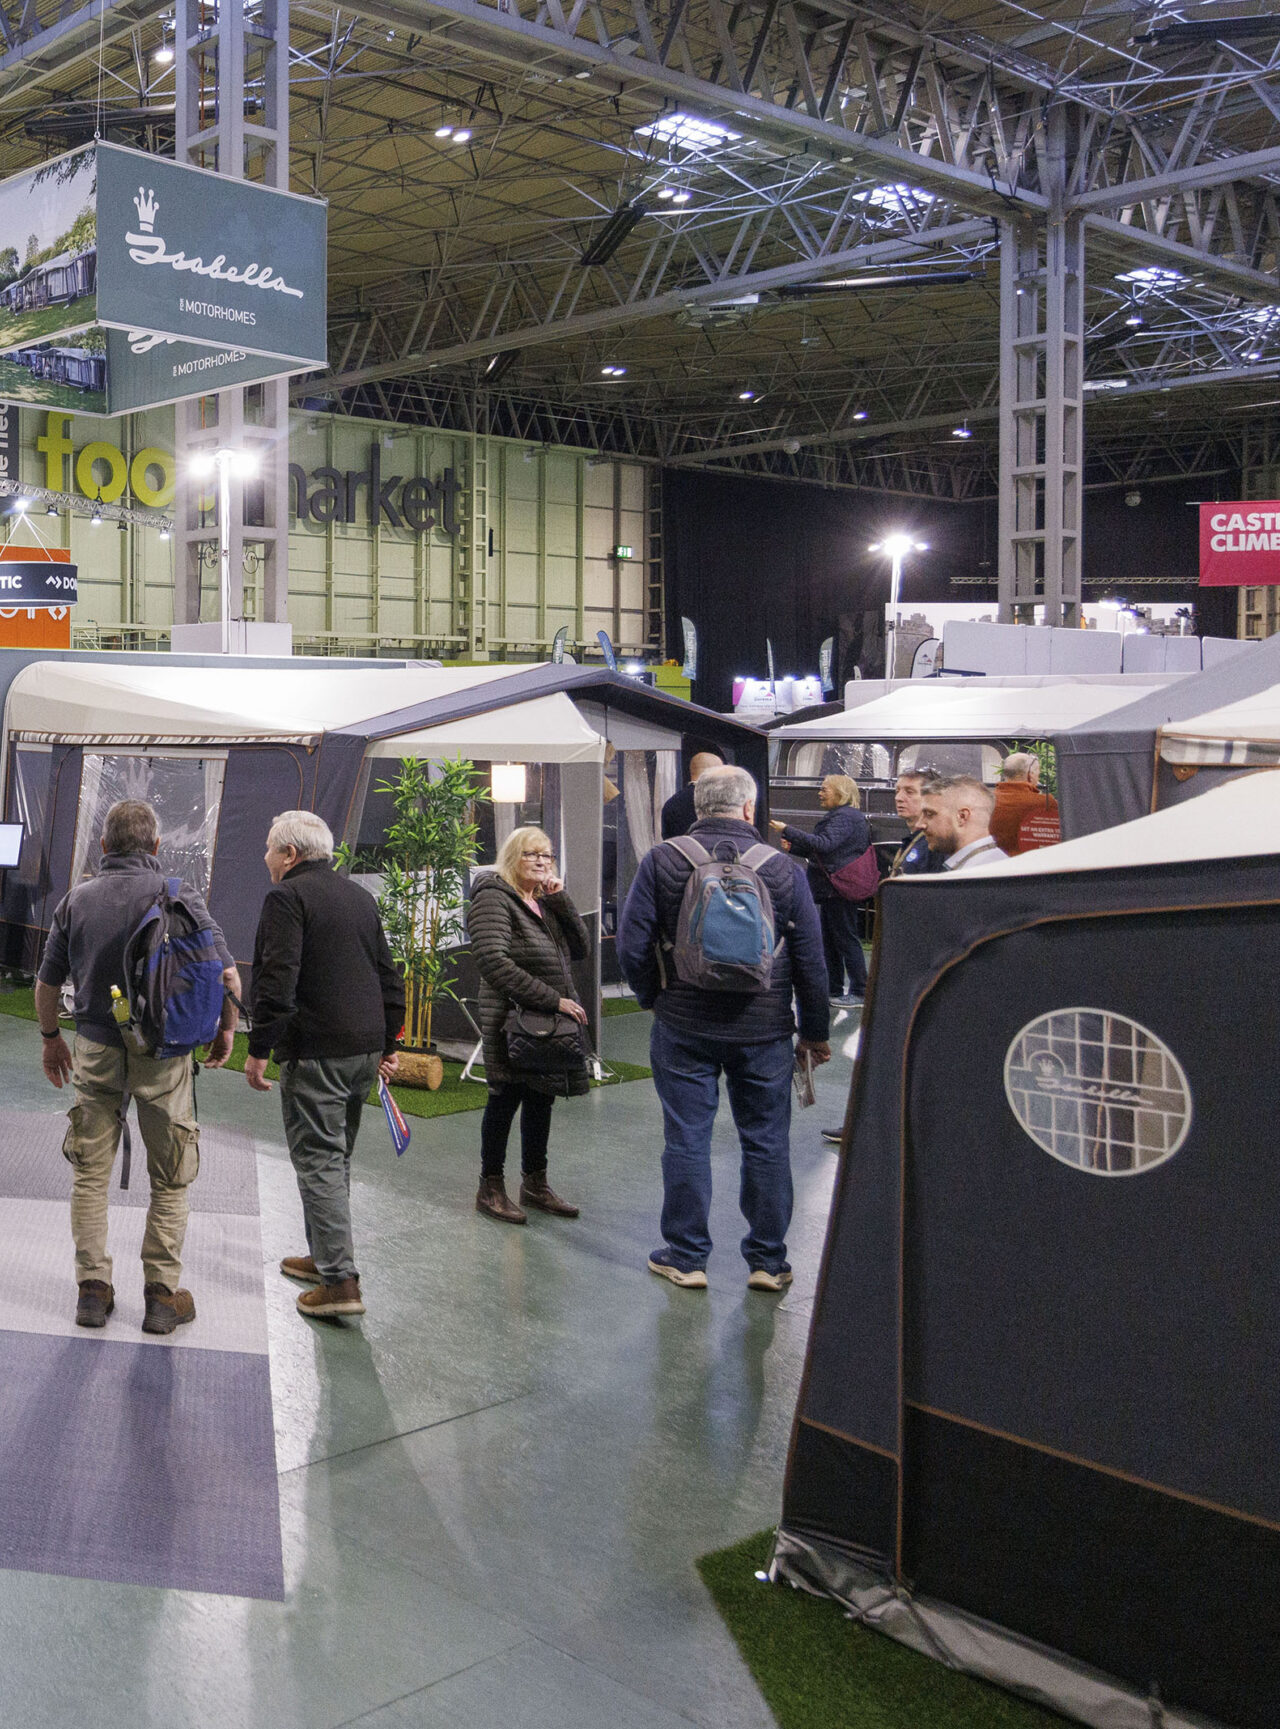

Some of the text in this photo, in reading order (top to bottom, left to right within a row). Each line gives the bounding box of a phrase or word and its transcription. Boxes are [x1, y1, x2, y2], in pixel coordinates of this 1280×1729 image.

[125, 231, 304, 299] Isabella
[185, 299, 257, 326] MOTORHOMES
[178, 349, 247, 376] MOTORHOMES
[37, 411, 216, 511] foo
